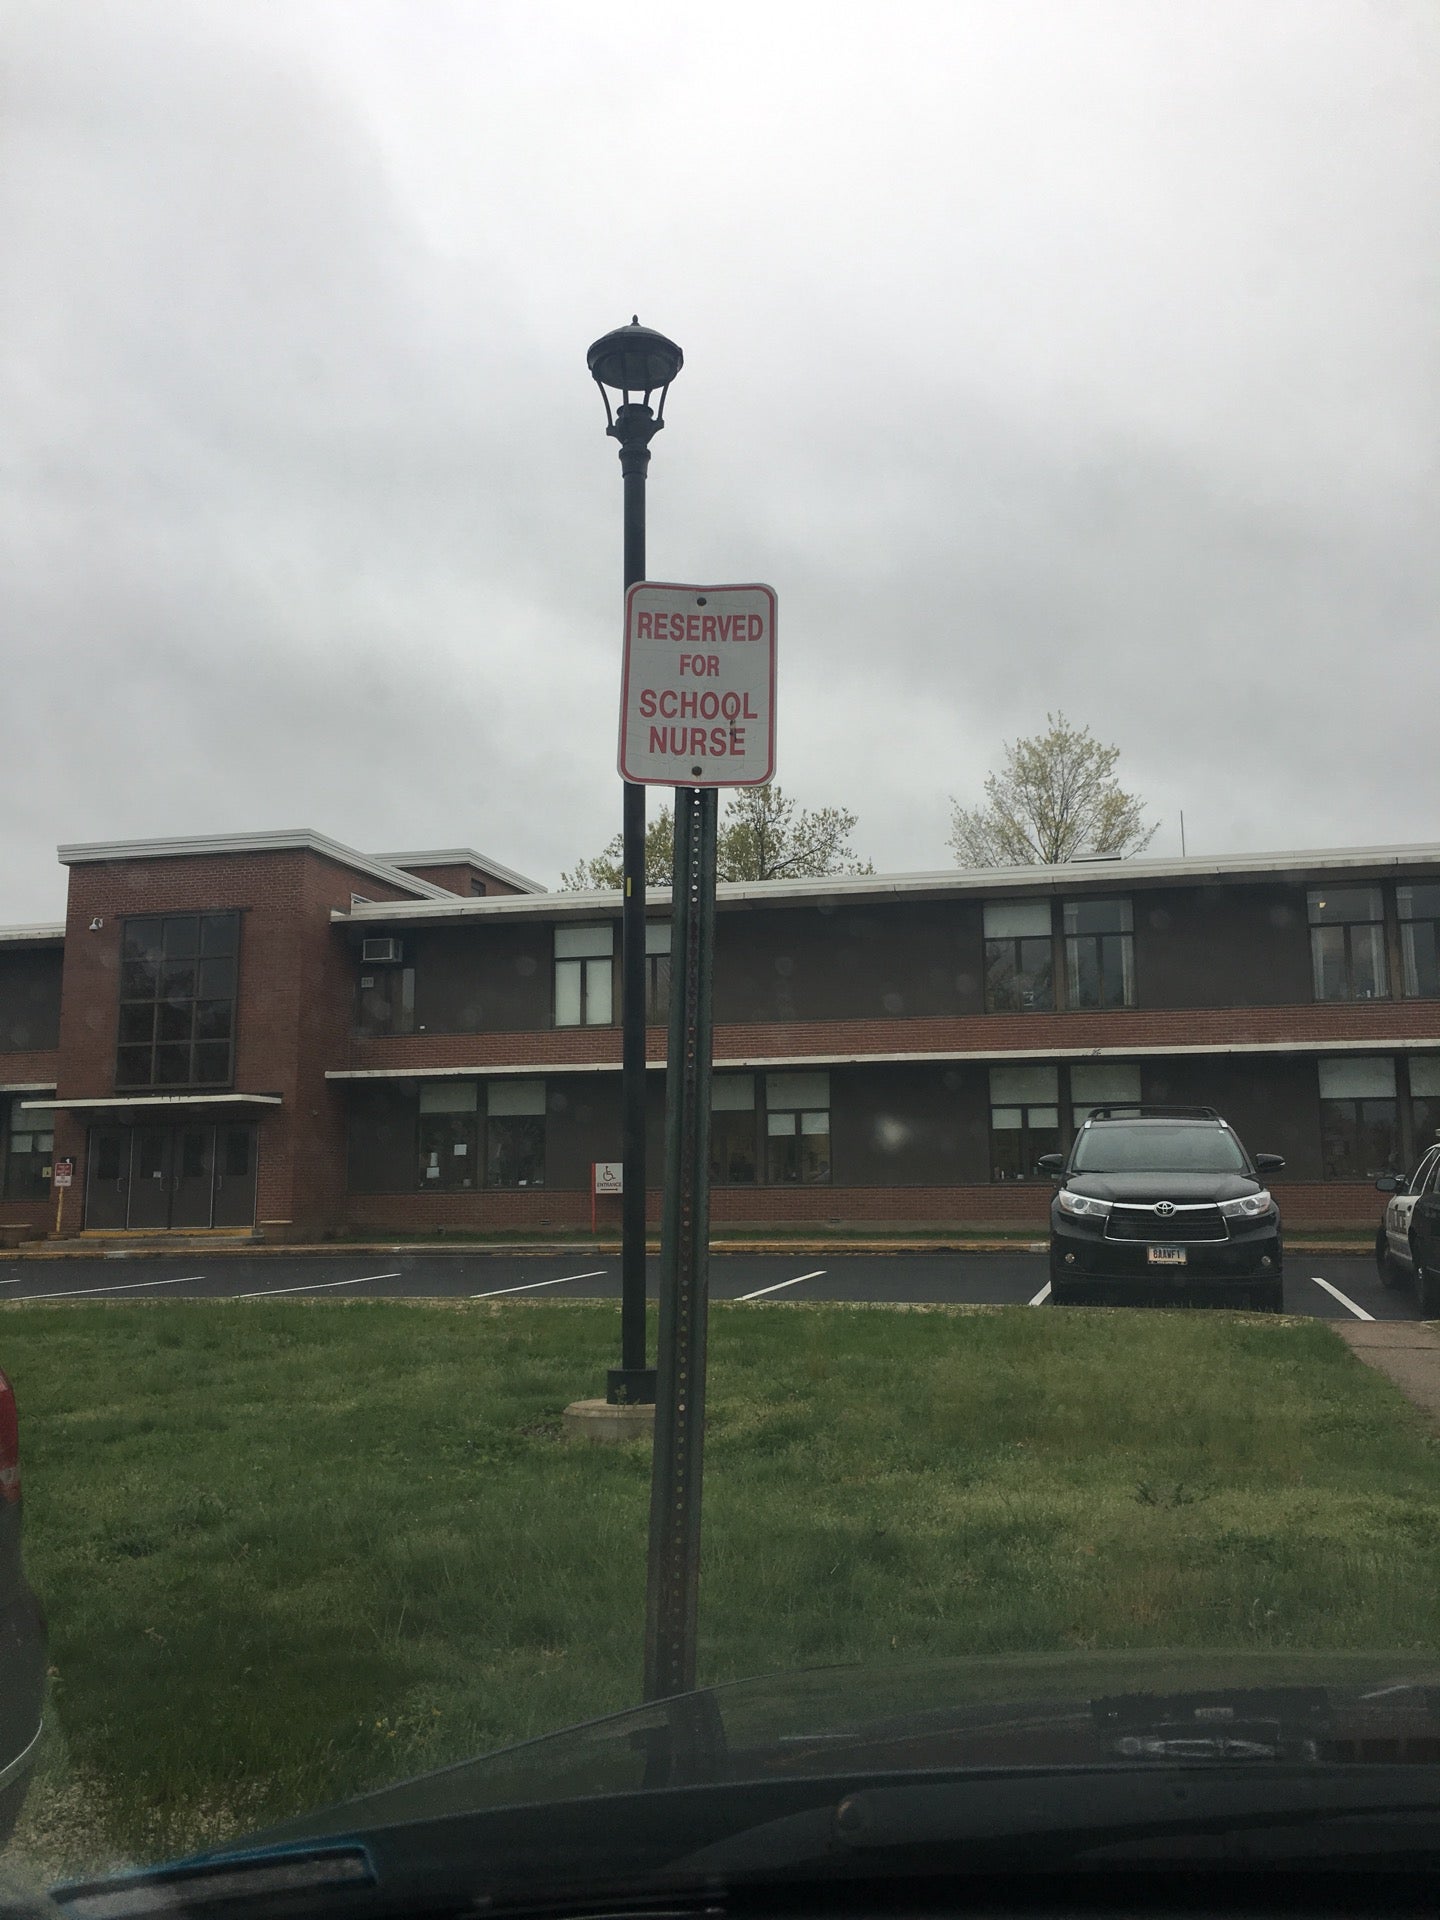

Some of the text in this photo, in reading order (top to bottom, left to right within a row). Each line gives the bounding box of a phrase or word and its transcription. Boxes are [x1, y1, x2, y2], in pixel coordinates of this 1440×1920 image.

[637, 612, 763, 642] RESERVED
[679, 654, 720, 676] FOR
[639, 689, 758, 720] SCHOOL
[649, 726, 745, 756] NURSE
